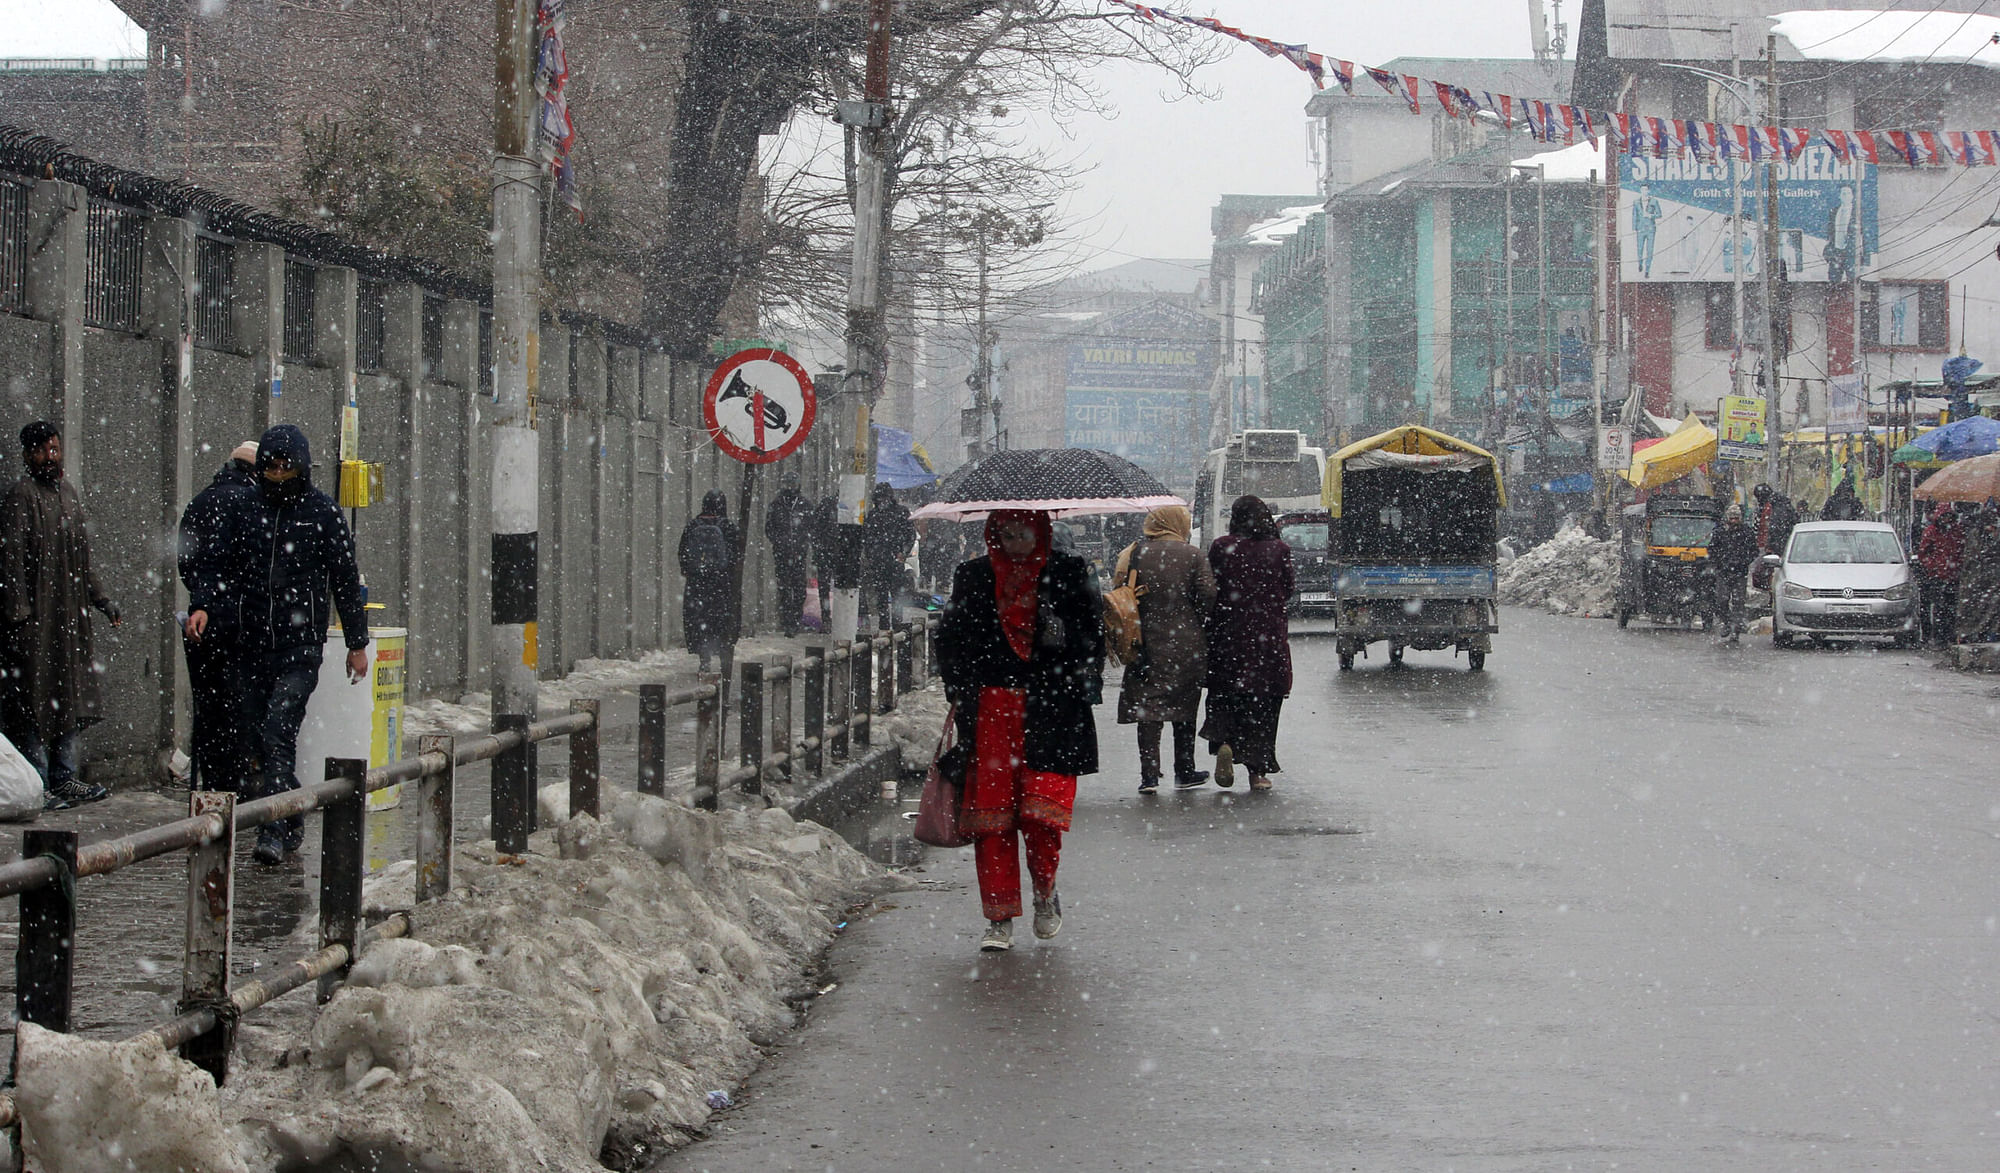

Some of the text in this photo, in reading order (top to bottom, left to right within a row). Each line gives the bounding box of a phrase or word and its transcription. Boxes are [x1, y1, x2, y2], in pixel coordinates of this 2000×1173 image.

[1631, 145, 1729, 181] SHADES
[1783, 187, 1821, 199] Gallery
[1083, 348, 1197, 365] YATRI NIWAS
